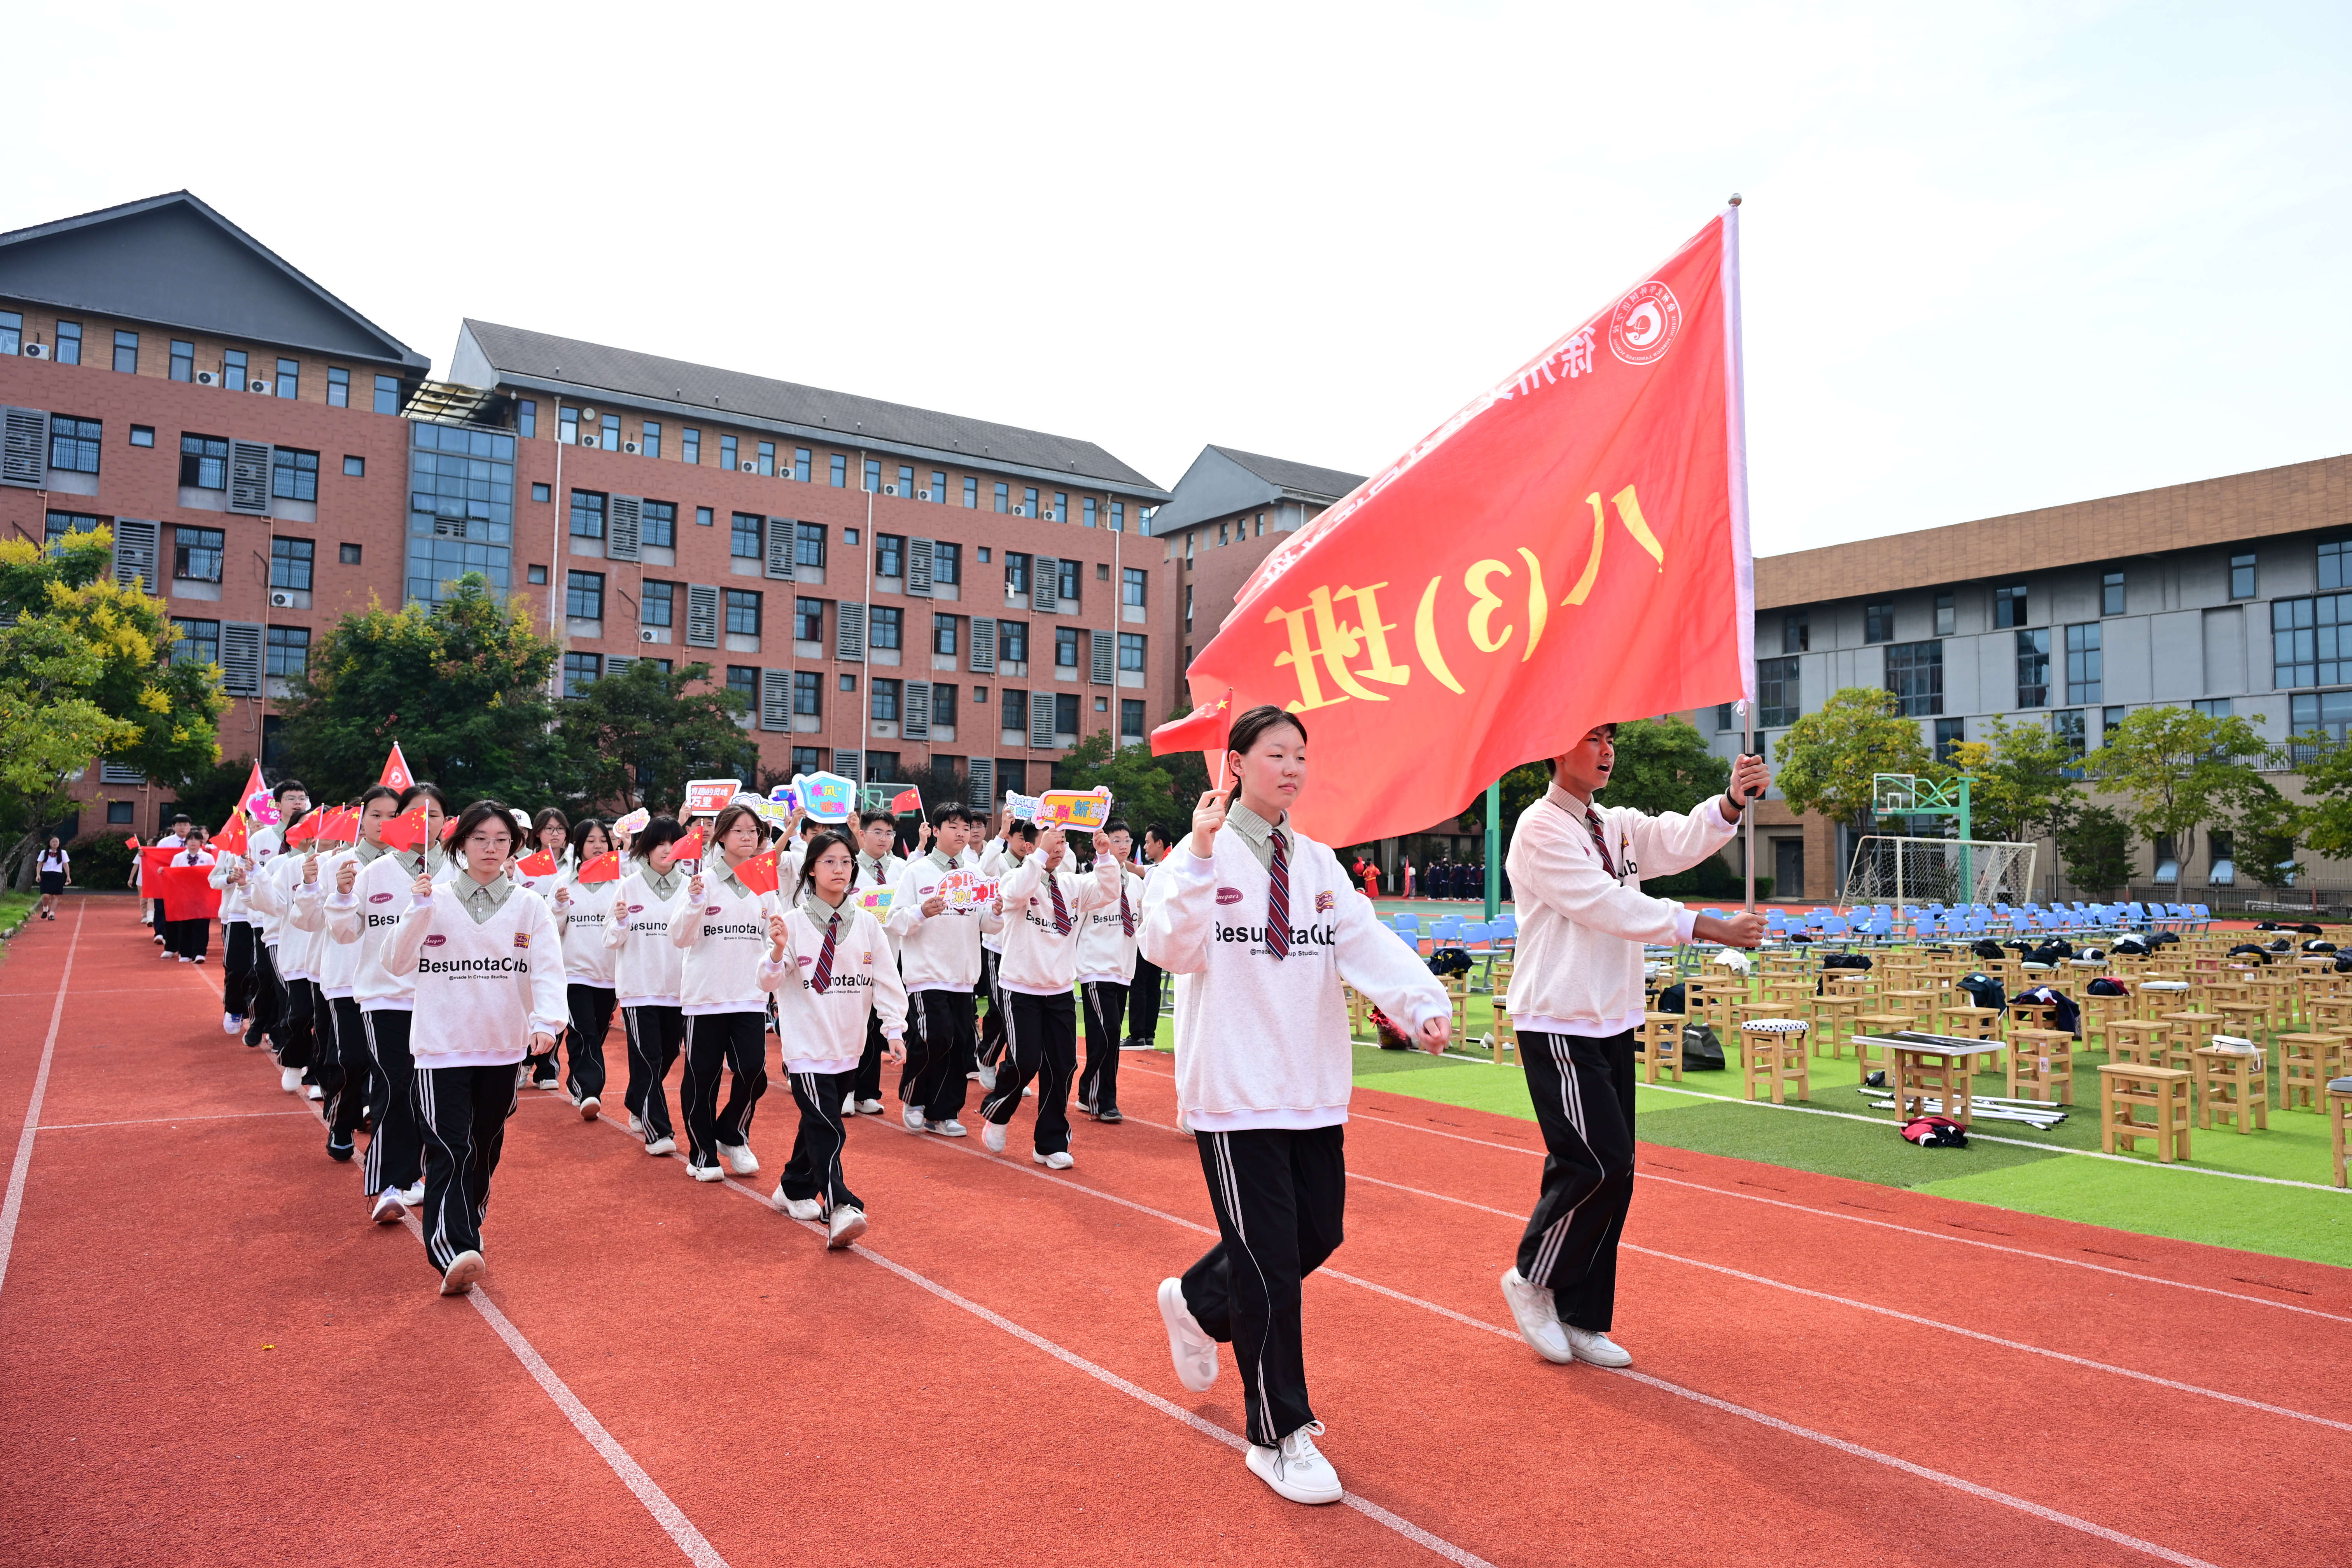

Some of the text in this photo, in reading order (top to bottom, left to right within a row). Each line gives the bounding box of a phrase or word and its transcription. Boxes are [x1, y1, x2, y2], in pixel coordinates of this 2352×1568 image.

[691, 787, 728, 796] 有趣的灵魂
[811, 784, 838, 797] 乘风
[758, 803, 785, 818] 冲鸭
[820, 800, 846, 814] 破浪
[1041, 799, 1107, 820] 披荆斩棘
[864, 893, 892, 907] 越努
